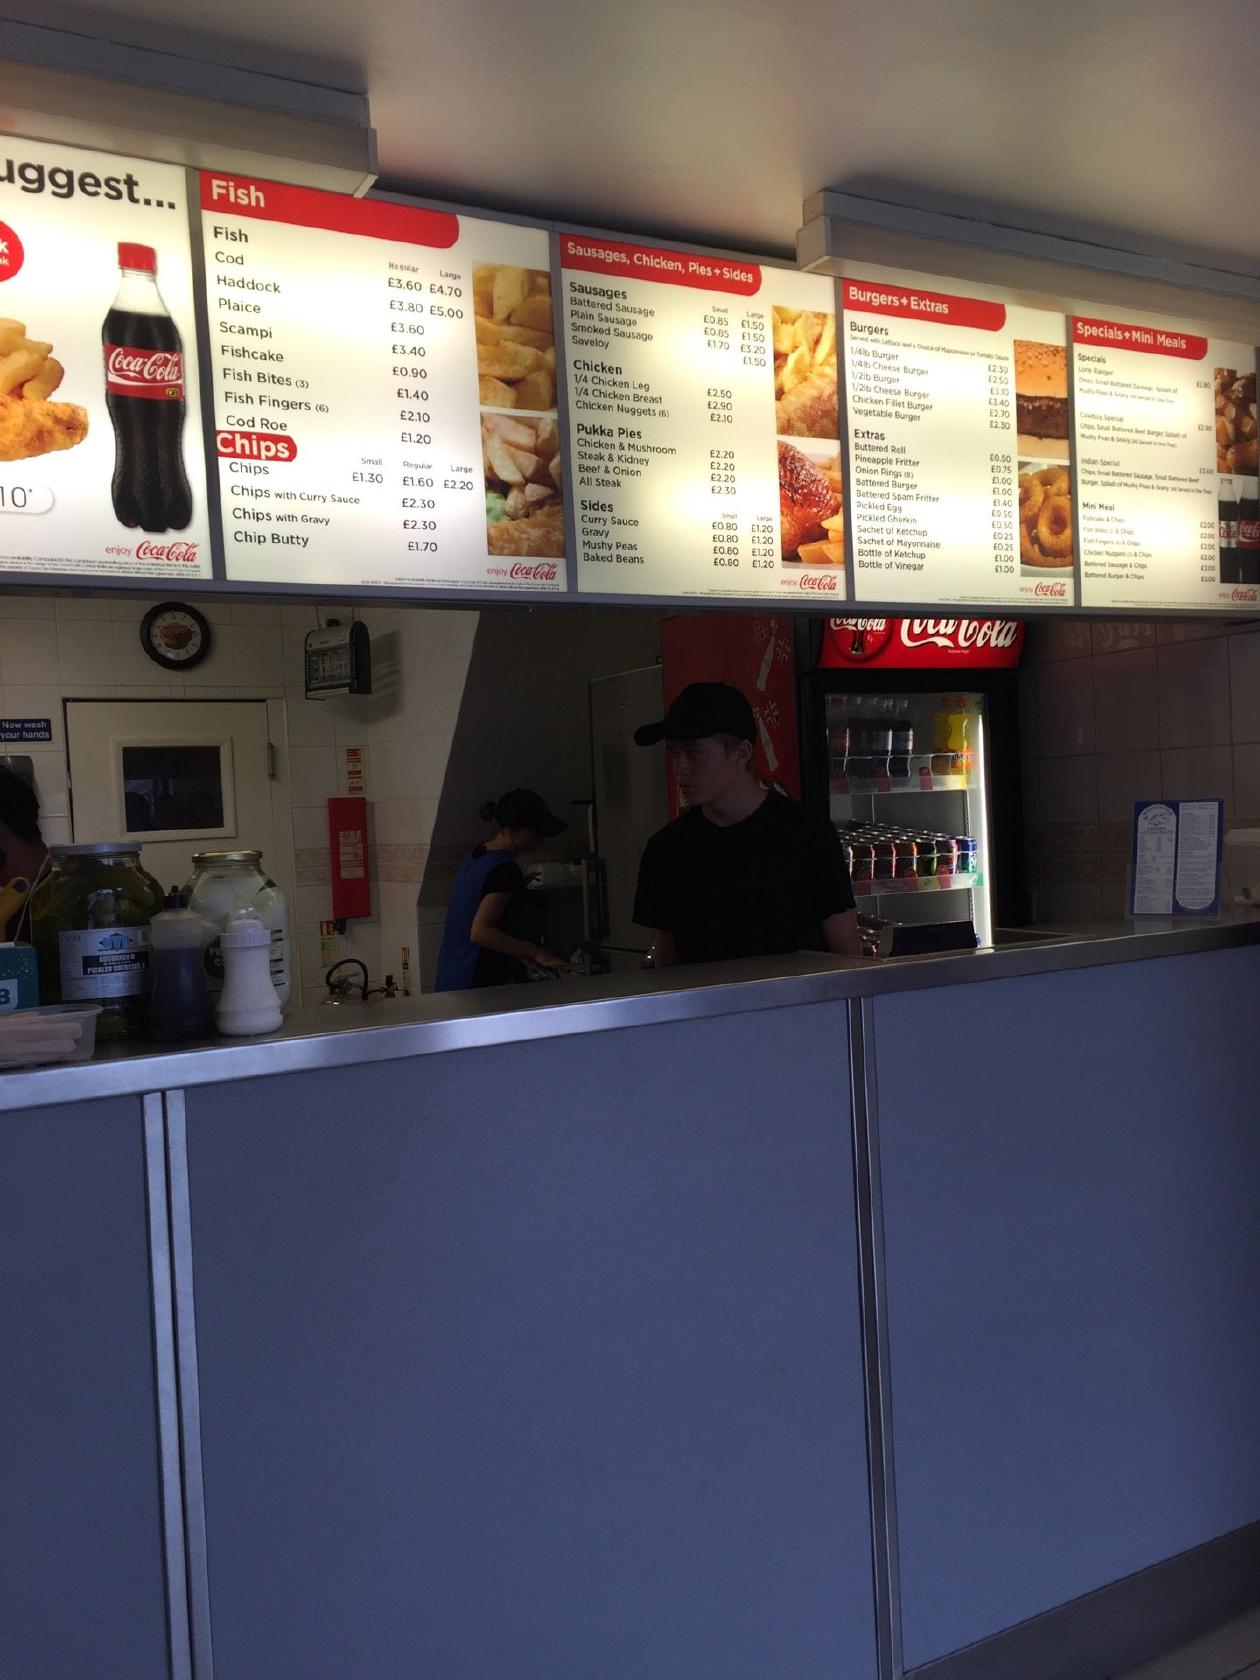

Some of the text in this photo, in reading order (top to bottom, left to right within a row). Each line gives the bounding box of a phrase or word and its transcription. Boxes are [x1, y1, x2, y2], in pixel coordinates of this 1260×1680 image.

[212, 179, 265, 207] Fish
[214, 226, 248, 242] Fish
[215, 252, 244, 264] Cod
[568, 242, 630, 264] Sausages,
[634, 254, 685, 274] Chicken,
[388, 262, 461, 280] Regular Large
[217, 275, 280, 293] Haddock
[388, 278, 462, 298] £3.60 £4.70
[570, 282, 626, 299] Sausages
[219, 298, 260, 313] Plaice
[390, 300, 463, 319] £3.80 £5.00
[570, 297, 654, 317] Battered Sausage
[571, 310, 637, 327] Plain Sausage
[220, 322, 272, 339] Scampi
[391, 322, 424, 335] £3.60
[571, 322, 653, 341] Smoked Sausage
[850, 321, 889, 335] Burgers
[572, 335, 609, 349] Saveloy
[1157, 334, 1186, 349] Meals
[221, 345, 283, 362] Fishcake
[392, 344, 425, 357] £3.40
[872, 349, 898, 361] Burger
[109, 348, 179, 380] Coca-Cola
[1078, 353, 1106, 364] Specials
[392, 366, 427, 379] £0.90
[574, 360, 622, 374] Chicken
[223, 368, 309, 388] Fish Bites (3)
[574, 375, 649, 392] 1/4 Chicken Leg
[397, 388, 428, 400] £1.40
[575, 387, 662, 404] 1/4 Chicken Breast
[708, 389, 732, 398] £2.50
[225, 392, 328, 413] Fish Fingers (6)
[576, 400, 613, 412] Chicken
[617, 405, 656, 416] Nuggets
[708, 401, 732, 411] £2.90
[853, 395, 933, 411] Chicken Fillet Burger
[400, 410, 430, 422] £2.10
[711, 413, 732, 423] £2.10
[853, 407, 920, 422] Vegetable Burger
[227, 415, 287, 430] Cod Roe
[401, 432, 431, 444] £1.20
[577, 424, 642, 439] Pukka Pies
[854, 429, 885, 440] Extras
[217, 432, 289, 459] Chips
[578, 438, 676, 455] Chicken & Mushroom
[855, 443, 905, 454] Buttered Roll
[578, 451, 649, 466] Steak & Kidney
[855, 454, 919, 467] Pineapple Fritter
[229, 462, 269, 475] Chips
[404, 461, 432, 469] Regular
[451, 465, 472, 473] Large
[579, 464, 641, 476] Beef & Onion
[856, 466, 878, 475] Onion
[881, 468, 902, 478] Rings
[353, 472, 473, 490] £1.30 £1.60 £2.20
[579, 477, 621, 488] All Steak
[856, 478, 917, 490] Battered Burger
[231, 485, 360, 504] Chips with Curry Sauce
[402, 498, 435, 508] £2.30
[581, 500, 614, 512] Sides
[233, 508, 330, 526] Chips with Gravy
[581, 515, 638, 526] Curry Sauce
[403, 520, 436, 530] £2.30
[234, 531, 309, 548] Chip Butty
[582, 528, 609, 538] Gravy
[106, 540, 199, 562] enjoy Coca-Cola
[408, 542, 438, 552] £1.70
[582, 541, 638, 551] Mushy Peas
[714, 546, 738, 555] £0.80
[584, 553, 644, 564] Baked Beans
[858, 549, 926, 560] Bottle of Ketchup
[714, 558, 739, 567] £0.80
[859, 560, 924, 571] Bottle of Vinegar
[487, 563, 557, 580] enjoy Coca-Cola
[830, 618, 886, 630] CocaCola
[901, 619, 1018, 648] CocaCola
[24, 720, 46, 728] wash
[0, 730, 49, 740] your hands
